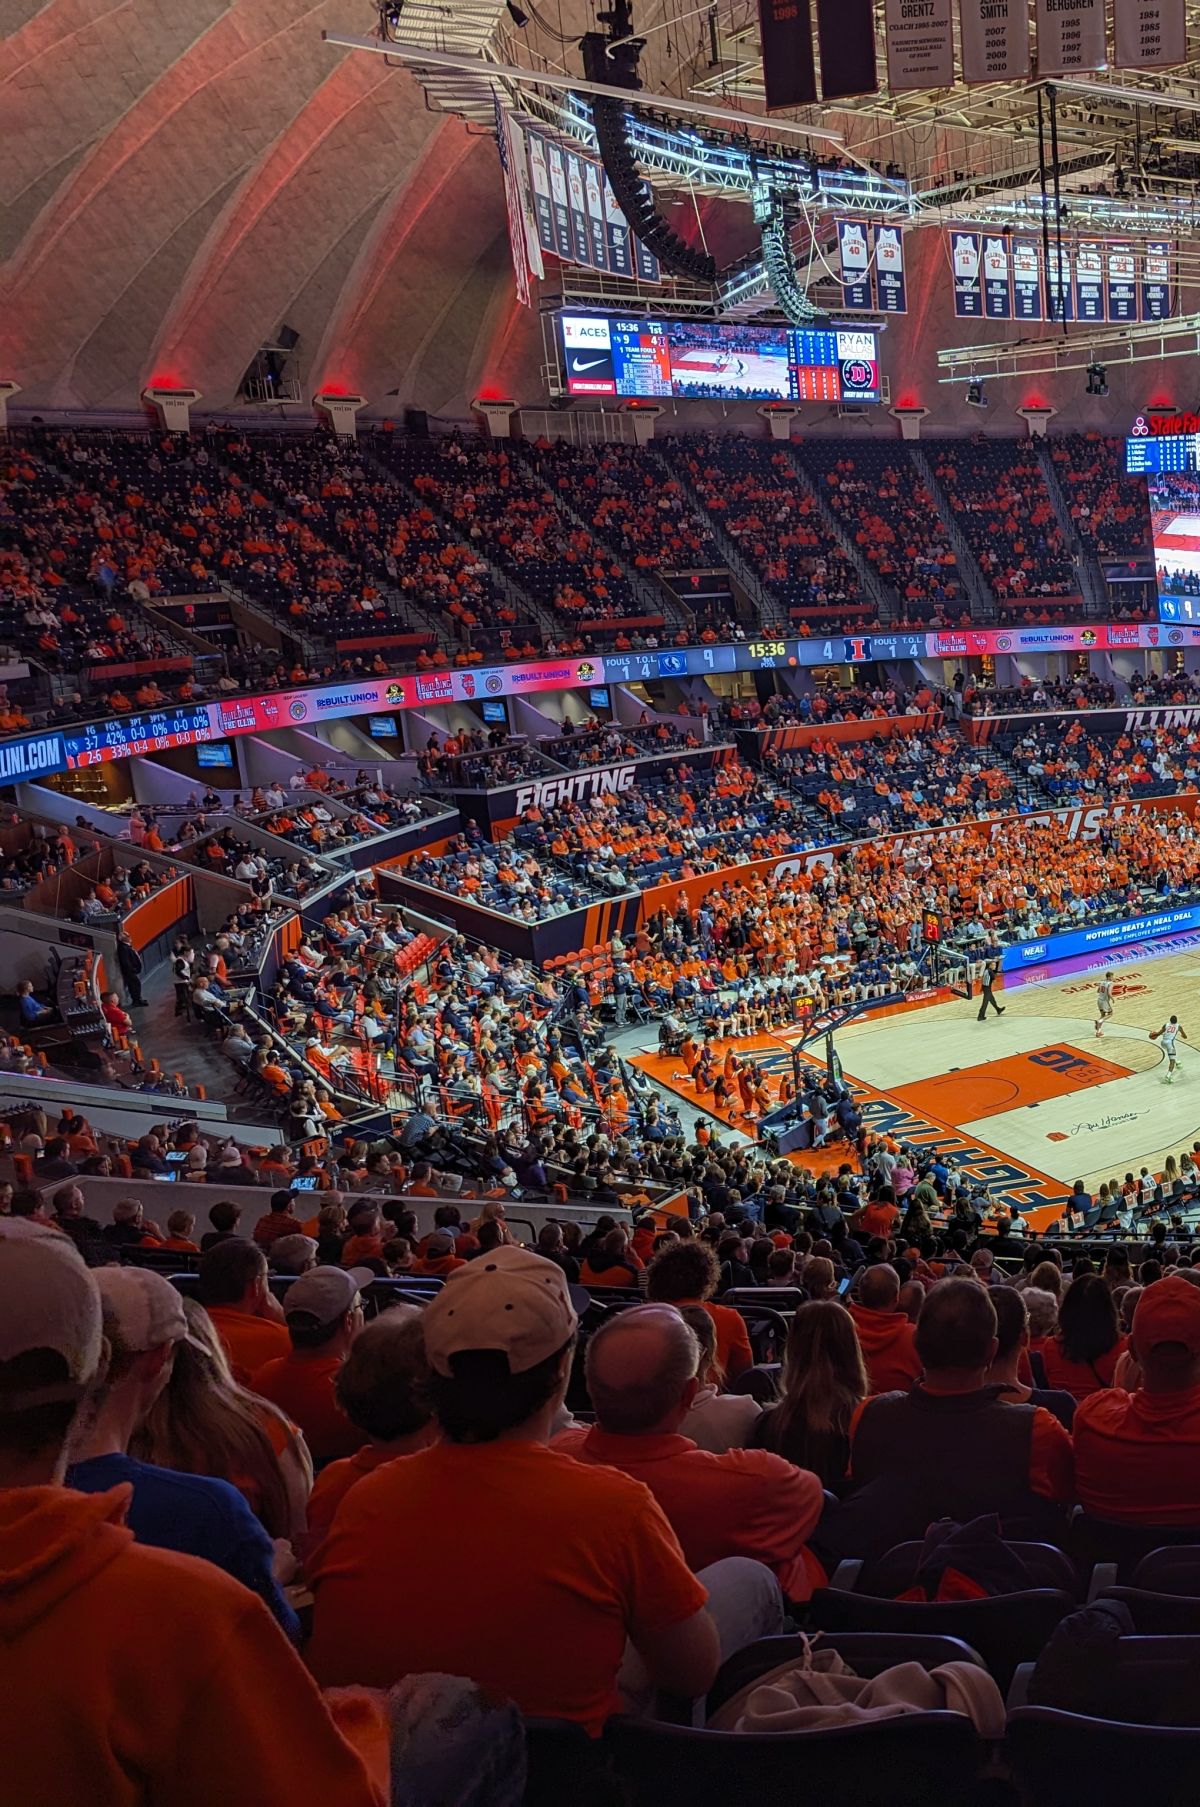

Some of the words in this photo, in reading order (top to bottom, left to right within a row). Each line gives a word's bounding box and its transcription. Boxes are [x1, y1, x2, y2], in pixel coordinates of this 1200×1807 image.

[901, 3, 934, 18] GRENTZ
[1046, 0, 1095, 12] BERGGREN
[773, 7, 798, 20] 1998
[980, 4, 1008, 20] SMITH
[1139, 10, 1160, 20] 1984
[889, 24, 914, 32] COACH
[915, 20, 948, 30] 1995-2007
[1060, 18, 1080, 28] 1995
[1139, 22, 1160, 32] 1985
[985, 26, 1006, 36] 2007
[1061, 31, 1081, 40] 1996
[986, 39, 1006, 48] 2008
[1140, 35, 1161, 44] 1986
[1062, 43, 1082, 52] 1997
[1140, 47, 1161, 56] 1987
[986, 51, 1007, 60] 2009
[1062, 56, 1082, 64] 1998
[986, 63, 1007, 72] 2010
[849, 247, 860, 255] 40
[884, 250, 894, 258] 33
[962, 256, 970, 264] 11
[580, 328, 607, 337] ACES
[616, 323, 638, 332] 15:36
[650, 326, 662, 334] 1st
[623, 335, 630, 344] 9
[651, 336, 657, 345] 4
[840, 334, 872, 345] RYAN
[1184, 601, 1192, 618] 9
[874, 638, 897, 646] FOULS
[1050, 634, 1074, 642] UNION
[748, 642, 786, 658] 15:36
[823, 642, 833, 659] 4
[851, 640, 866, 660] I
[889, 645, 896, 658] 1
[909, 644, 918, 656] 4
[606, 657, 631, 666] FOULS
[703, 650, 715, 668] 9
[520, 673, 544, 682] BUILT
[545, 670, 570, 680] UNION
[622, 666, 630, 679] 1
[641, 664, 651, 677] 4
[421, 680, 452, 692] BUILDING
[324, 696, 349, 707] BUILT
[350, 692, 378, 702] UNION
[223, 707, 254, 721] BUILDING
[86, 726, 96, 735] FG
[105, 720, 121, 731] FG%
[130, 717, 142, 727] 3PT
[150, 713, 166, 724] 3PT%
[176, 710, 184, 718] FT
[224, 720, 237, 729] THE
[237, 718, 256, 728] ILLINI
[1124, 709, 1200, 731] ILLINI
[85, 737, 98, 750] 3-7
[106, 732, 126, 745] 42%
[131, 727, 146, 740] 0-0
[152, 722, 167, 736] 0%
[174, 719, 188, 732] 0-0
[193, 714, 208, 728] 0%
[88, 751, 102, 764] 2-6
[111, 744, 131, 758] 33%
[134, 740, 148, 753] 0-4
[155, 736, 170, 749] 0%
[176, 732, 191, 744] 0-0
[196, 728, 210, 741] 0%
[516, 766, 636, 816] FIGHTING
[1086, 928, 1120, 940] NOTHING
[1122, 923, 1144, 933] BEATS
[1154, 916, 1172, 926] NEAL
[1174, 912, 1192, 922] DEAL
[1124, 931, 1150, 940] EMPLOYEE
[1152, 926, 1171, 934] OWNED
[1024, 948, 1044, 956] NEAL
